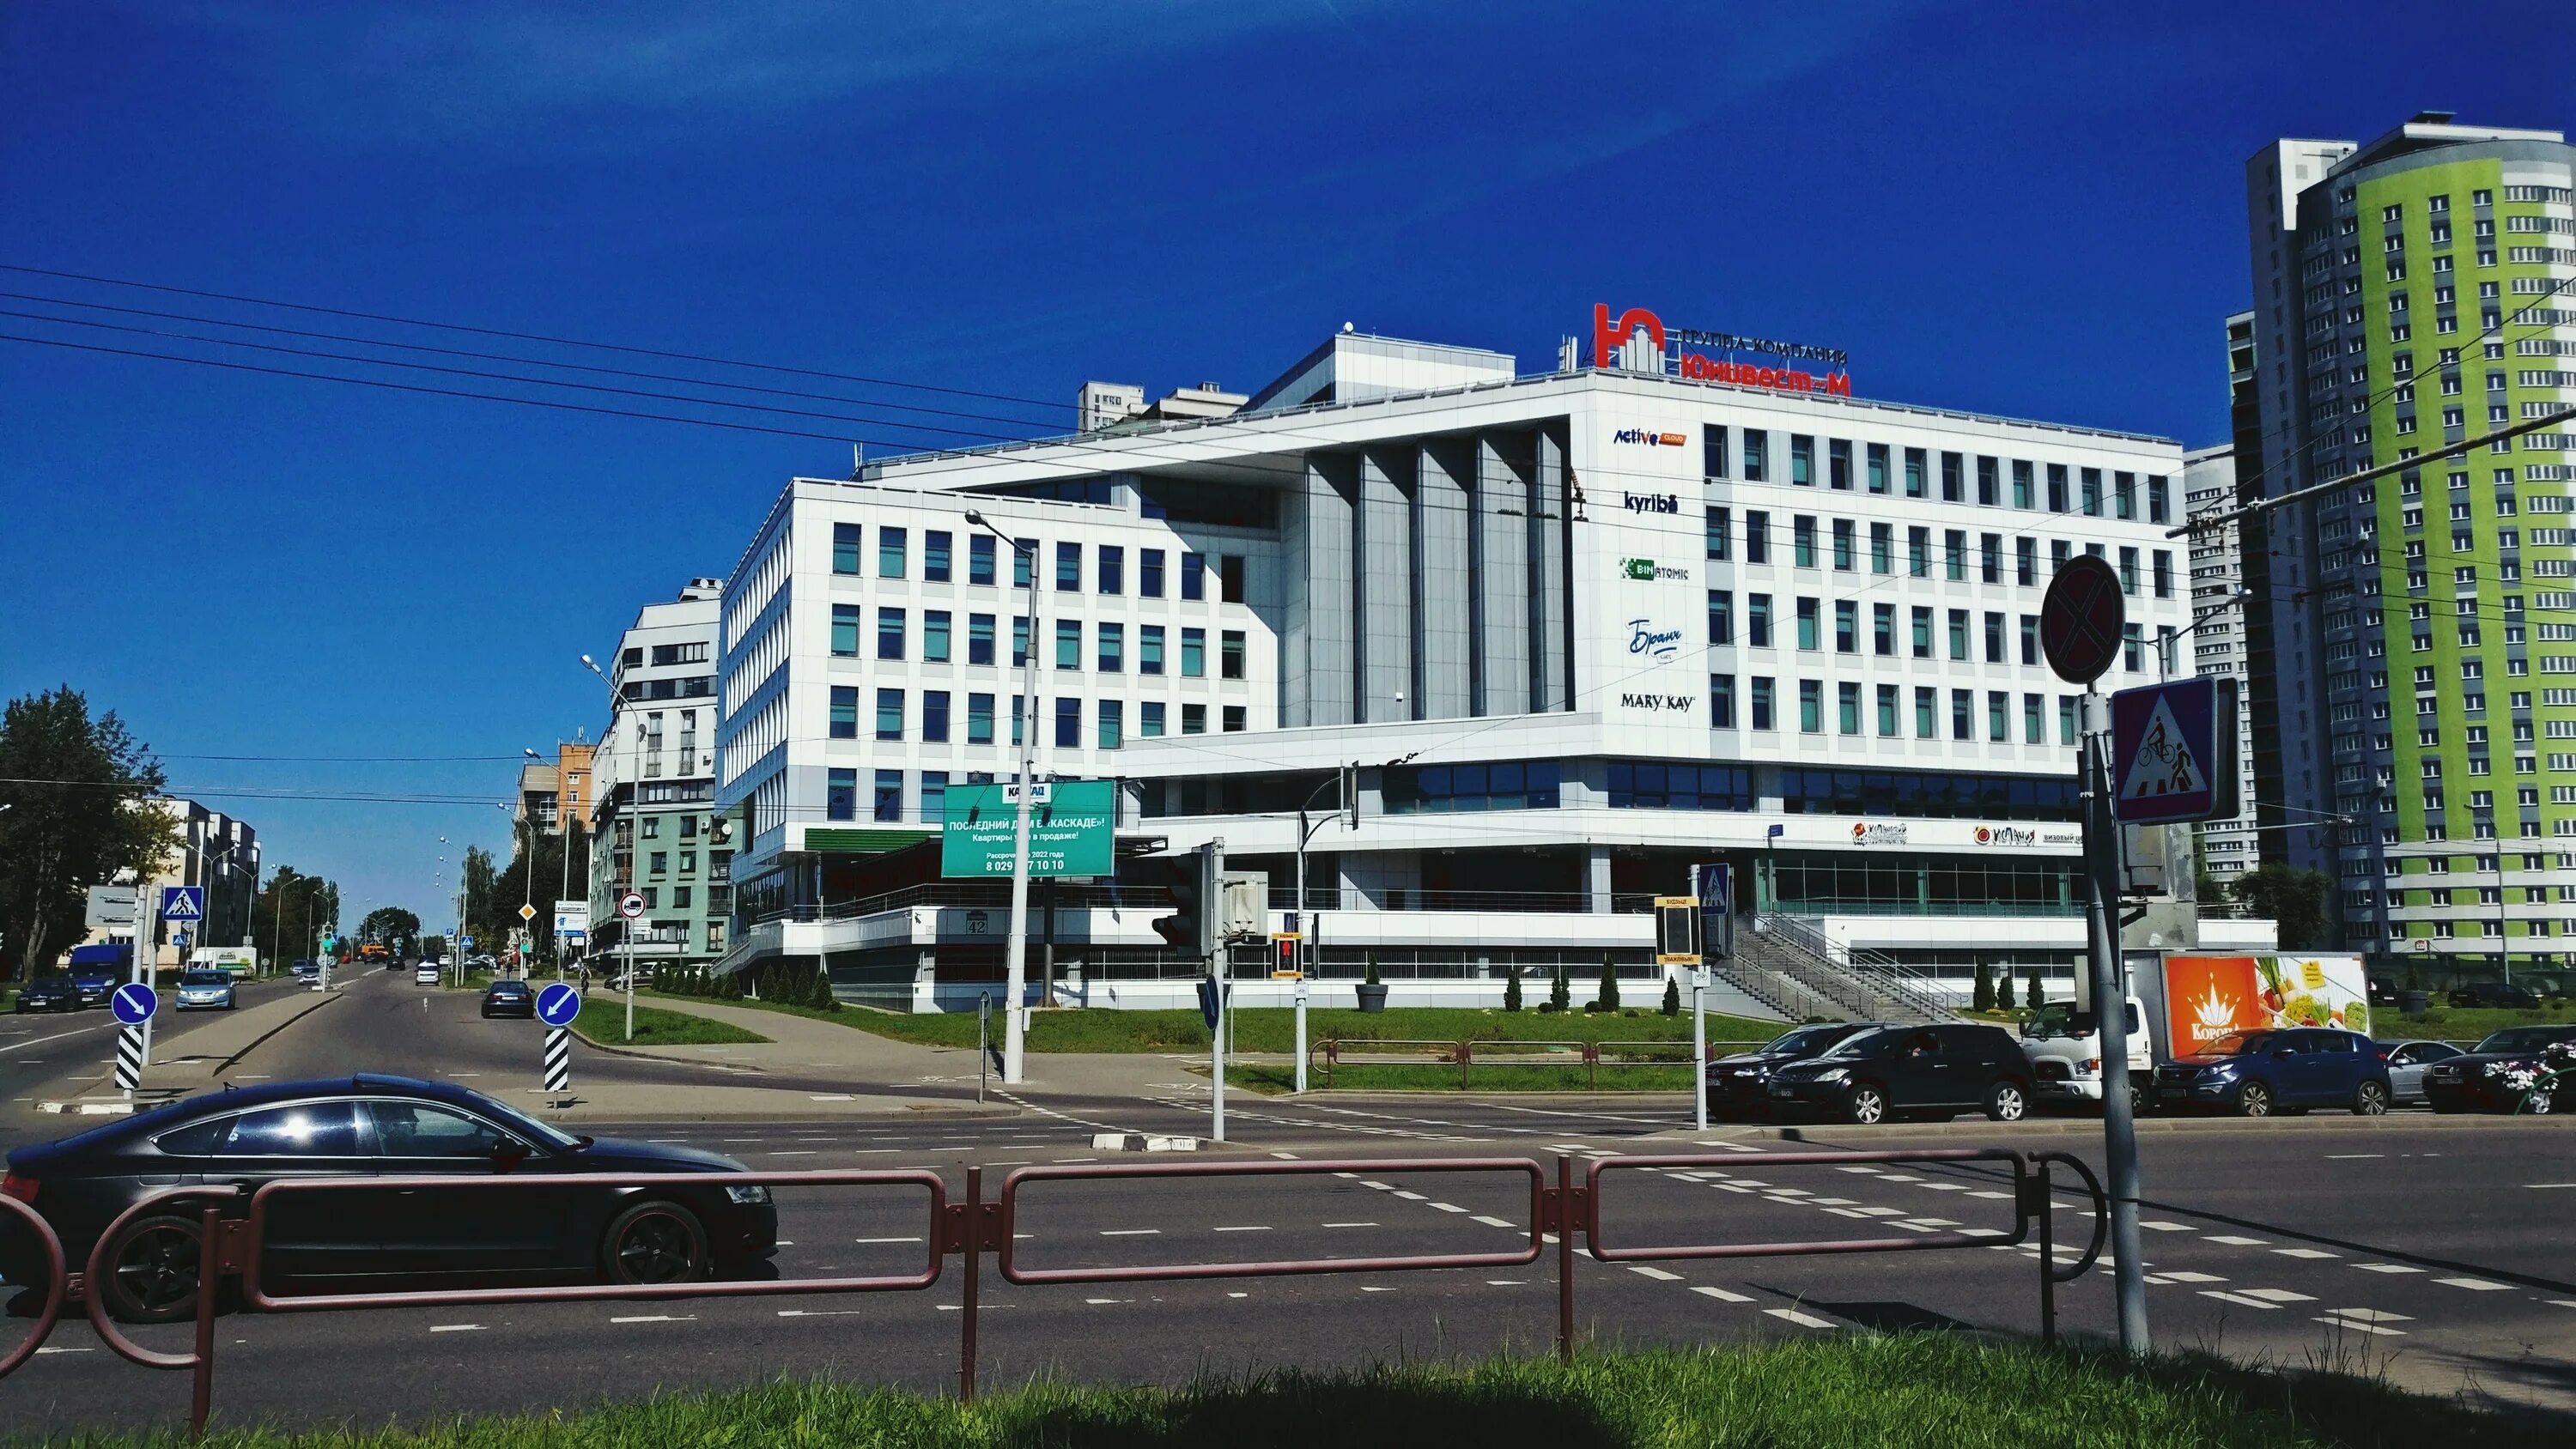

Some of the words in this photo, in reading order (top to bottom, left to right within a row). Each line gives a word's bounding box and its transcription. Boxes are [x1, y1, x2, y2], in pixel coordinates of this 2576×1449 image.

[1679, 329, 1747, 350] ГРУППА
[1625, 490, 1678, 514] kyriba
[1621, 693, 1662, 712] MARY
[1667, 695, 1696, 712] KAY
[972, 834, 1012, 843] Квартиры
[1040, 831, 1079, 842] продаже!
[1048, 851, 1065, 860] года
[986, 861, 993, 871] 8
[994, 861, 1013, 871] 029
[1038, 860, 1049, 870] 10
[1052, 859, 1065, 870] 10
[968, 921, 986, 934] 42
